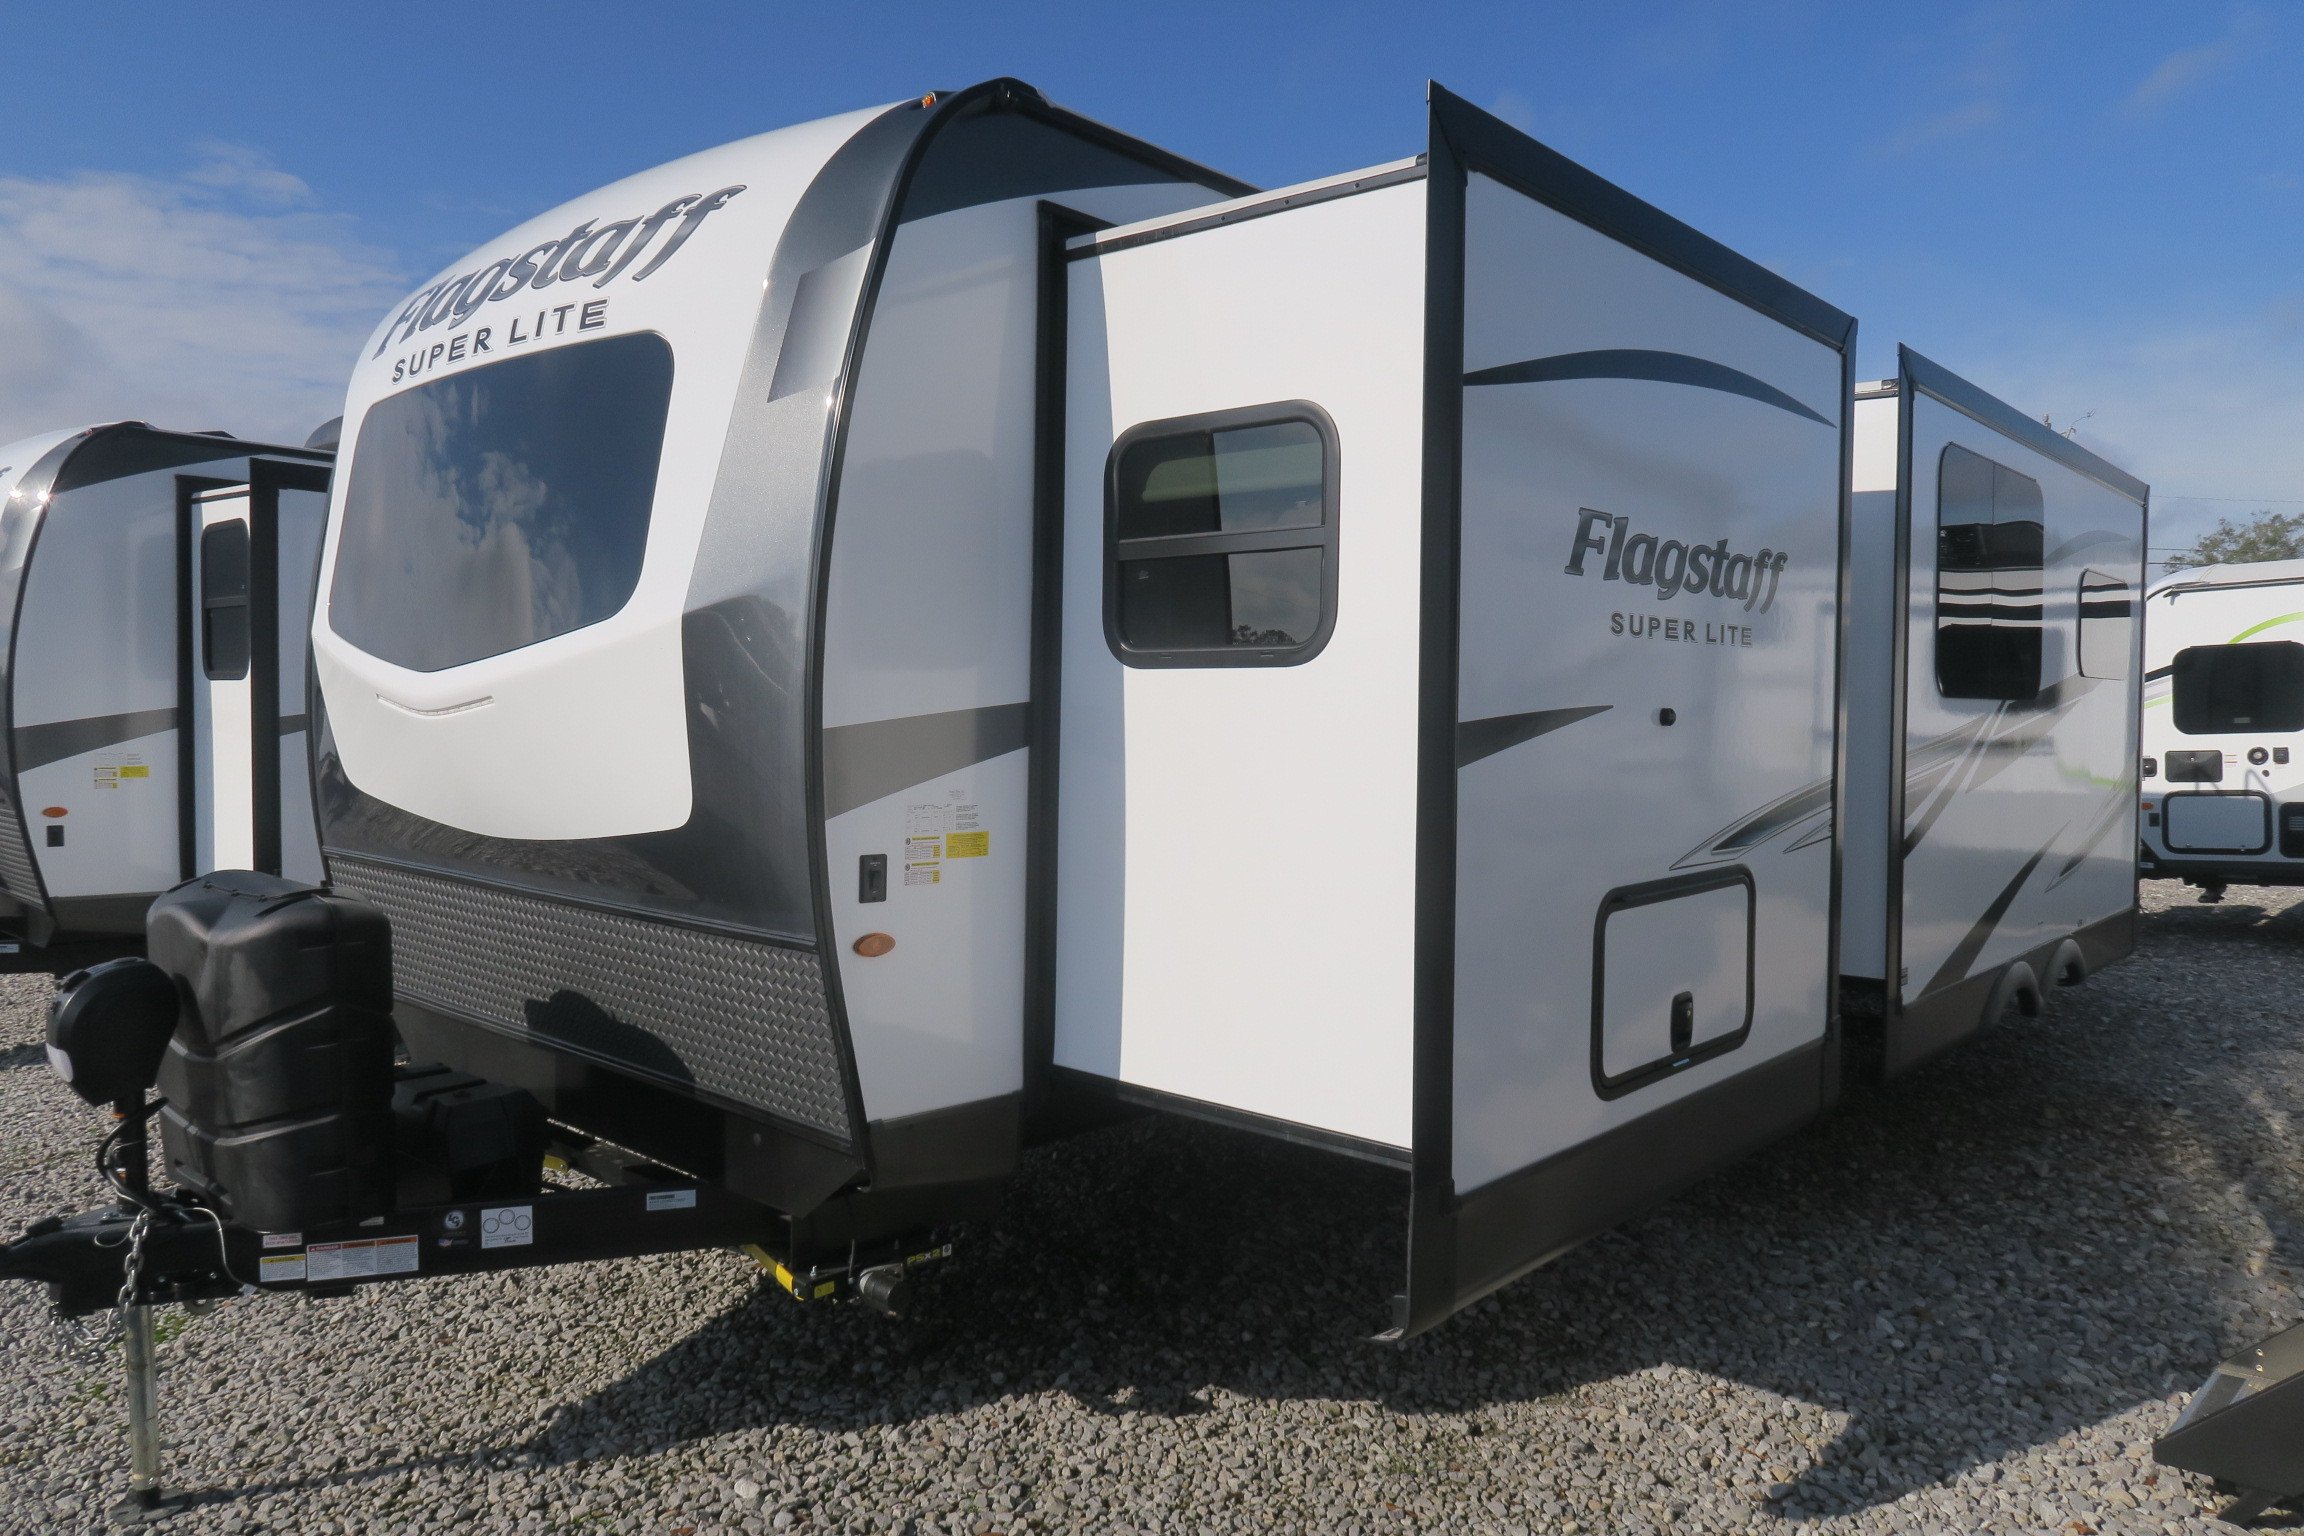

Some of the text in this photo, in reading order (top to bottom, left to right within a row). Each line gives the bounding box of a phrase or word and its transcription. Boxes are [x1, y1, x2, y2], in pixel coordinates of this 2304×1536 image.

[372, 184, 748, 361] Flagstaff
[392, 297, 611, 384] SUPER LITE
[1563, 506, 1789, 614] Flagstaff
[1610, 610, 1753, 648] SUPER LITE
